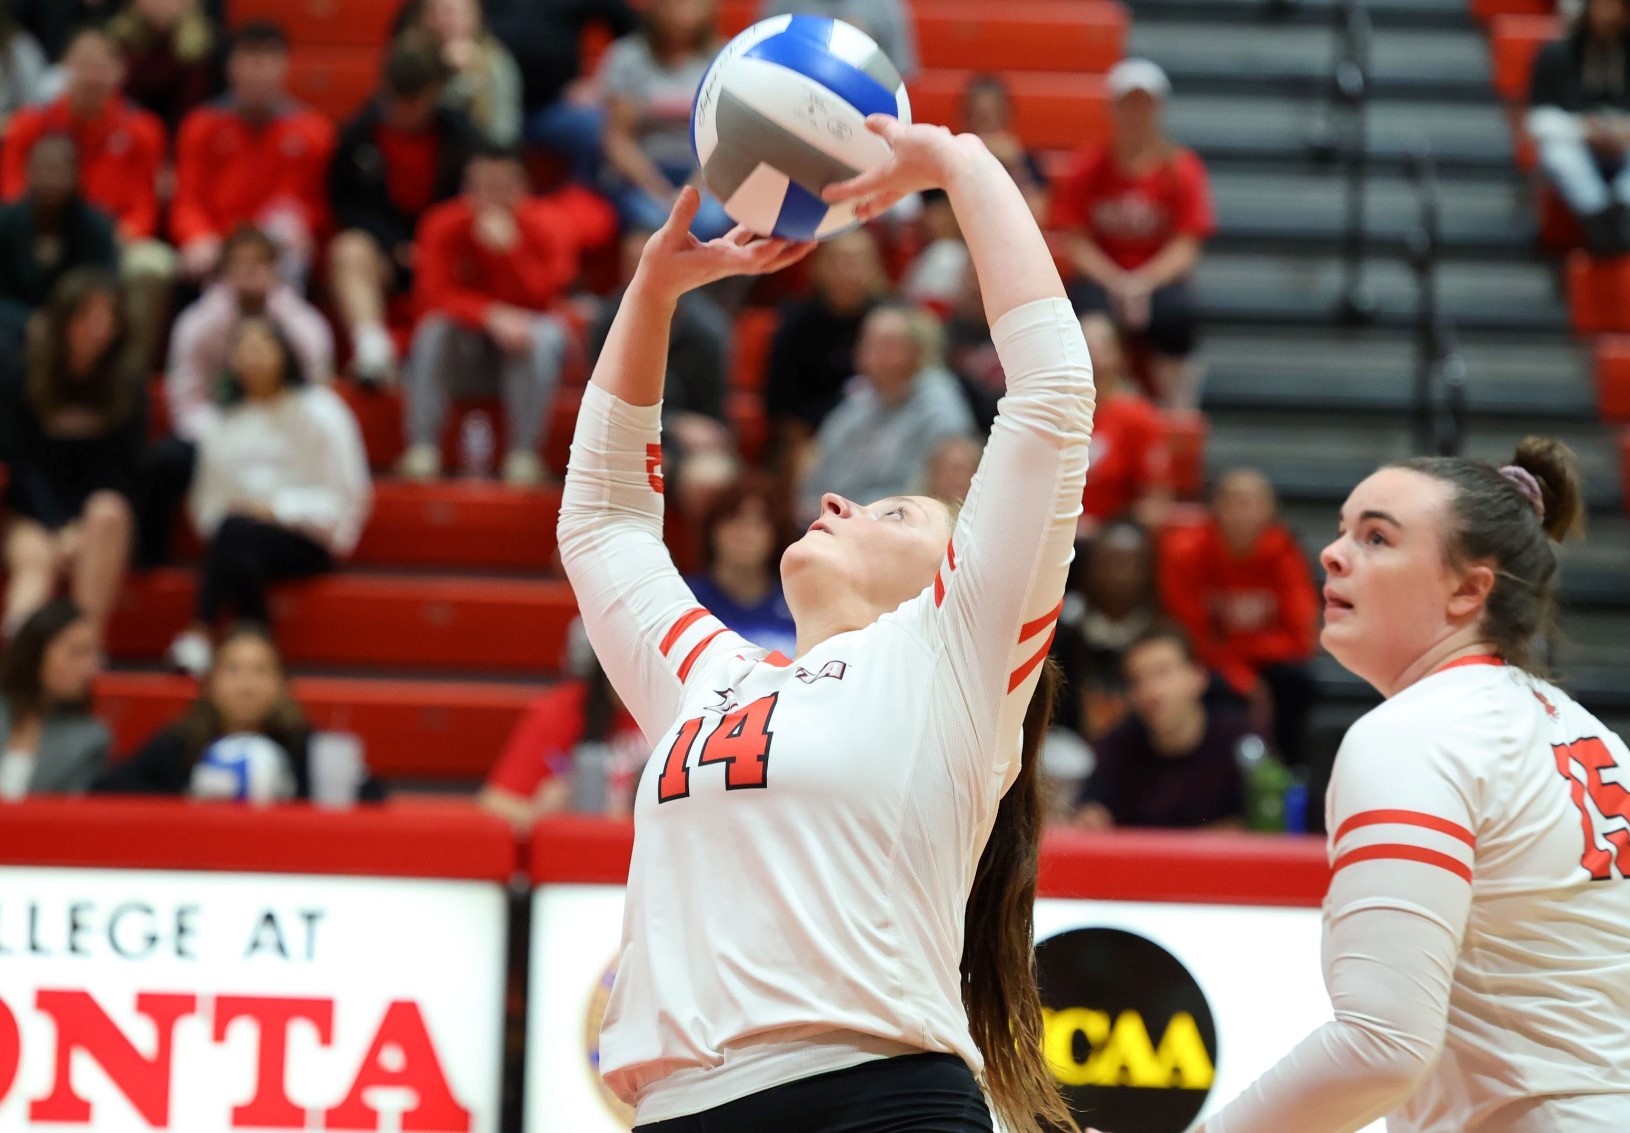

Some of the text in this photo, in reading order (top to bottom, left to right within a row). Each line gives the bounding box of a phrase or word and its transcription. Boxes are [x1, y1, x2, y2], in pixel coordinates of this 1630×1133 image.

[658, 691, 780, 805] 14
[1551, 736, 1630, 881] 15
[243, 908, 325, 960] AT
[0, 987, 472, 1133] NTA
[1009, 1006, 1216, 1089] CAA
